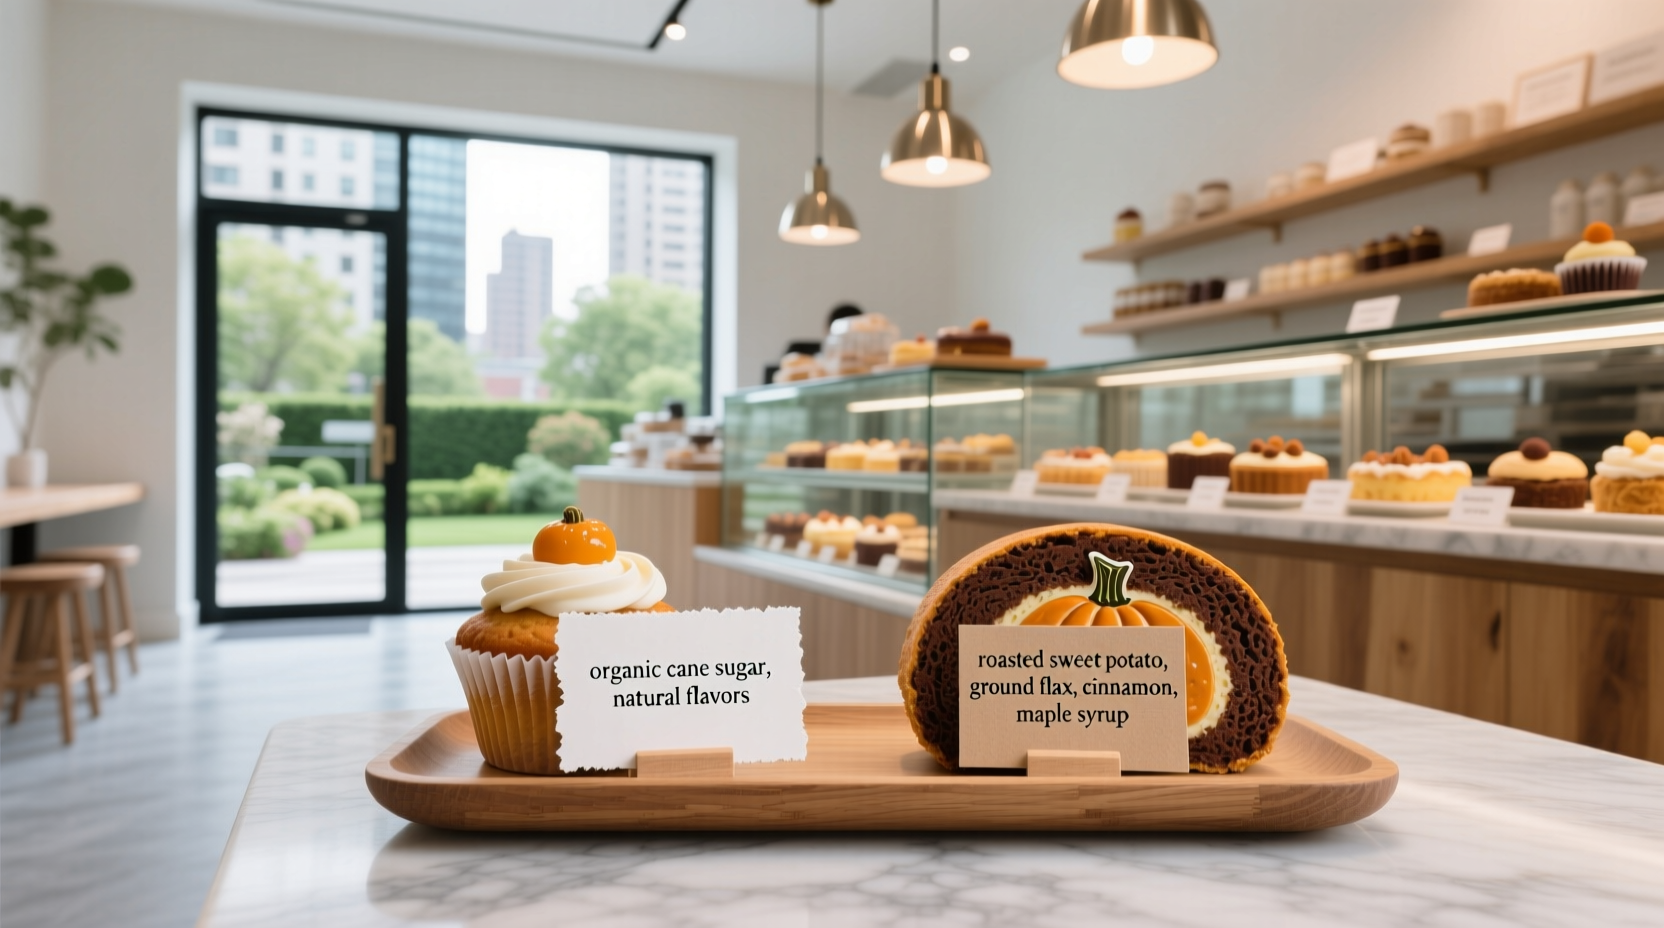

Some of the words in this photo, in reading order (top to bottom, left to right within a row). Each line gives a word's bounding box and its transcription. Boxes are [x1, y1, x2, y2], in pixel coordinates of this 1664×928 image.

[588, 658, 662, 685] organic
[666, 663, 710, 679] cane
[715, 661, 772, 682] sugar,
[978, 649, 1044, 669] roasted
[1049, 652, 1102, 669] sweet
[1105, 652, 1168, 673] potato,
[613, 686, 680, 708] natural
[686, 685, 750, 706] flavors
[969, 675, 1035, 700] ground
[1039, 675, 1078, 699] flax,
[1082, 677, 1178, 699] cinnamon,
[1016, 702, 1072, 728] maple
[1077, 709, 1130, 729] syrup
